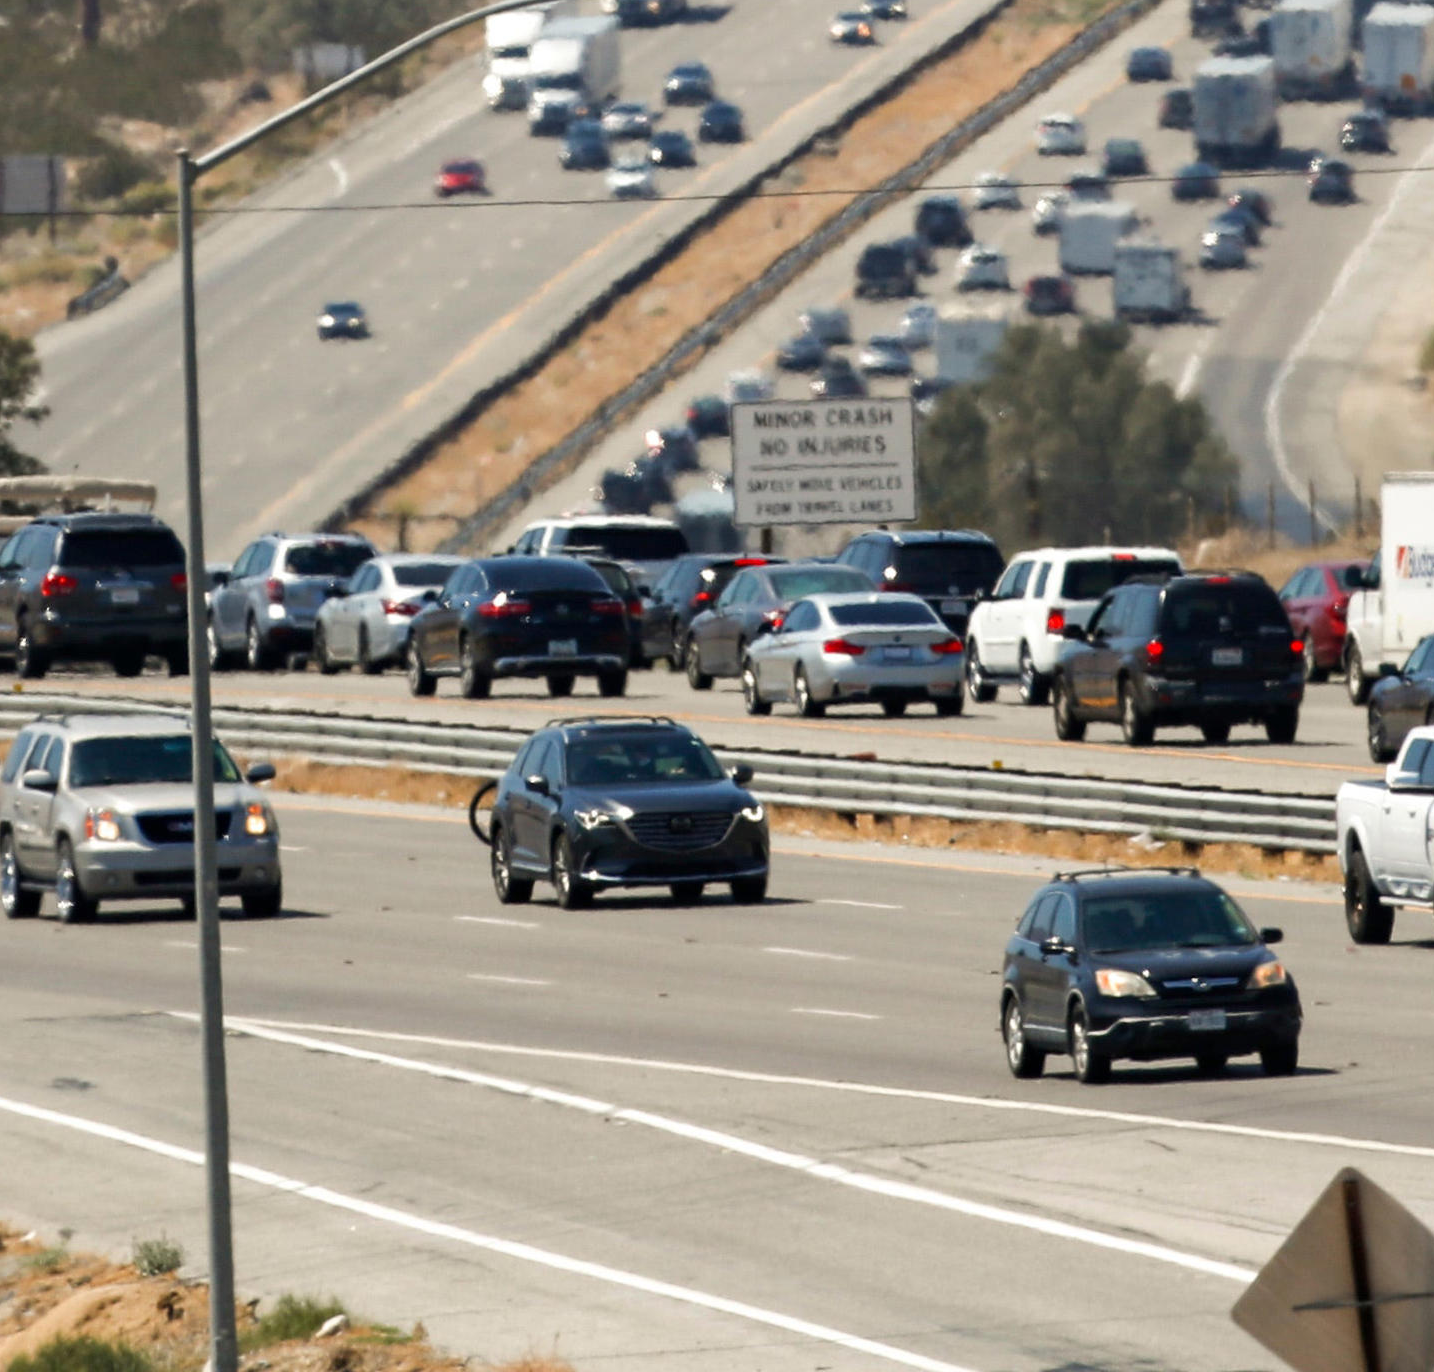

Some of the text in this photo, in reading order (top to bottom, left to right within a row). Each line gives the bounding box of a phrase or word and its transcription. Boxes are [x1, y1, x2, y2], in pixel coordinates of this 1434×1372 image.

[753, 408, 893, 428] MINOR CRASH
[760, 435, 887, 457] NO INJURIES
[840, 475, 903, 492] VEHICLES
[849, 498, 894, 514] LANES
